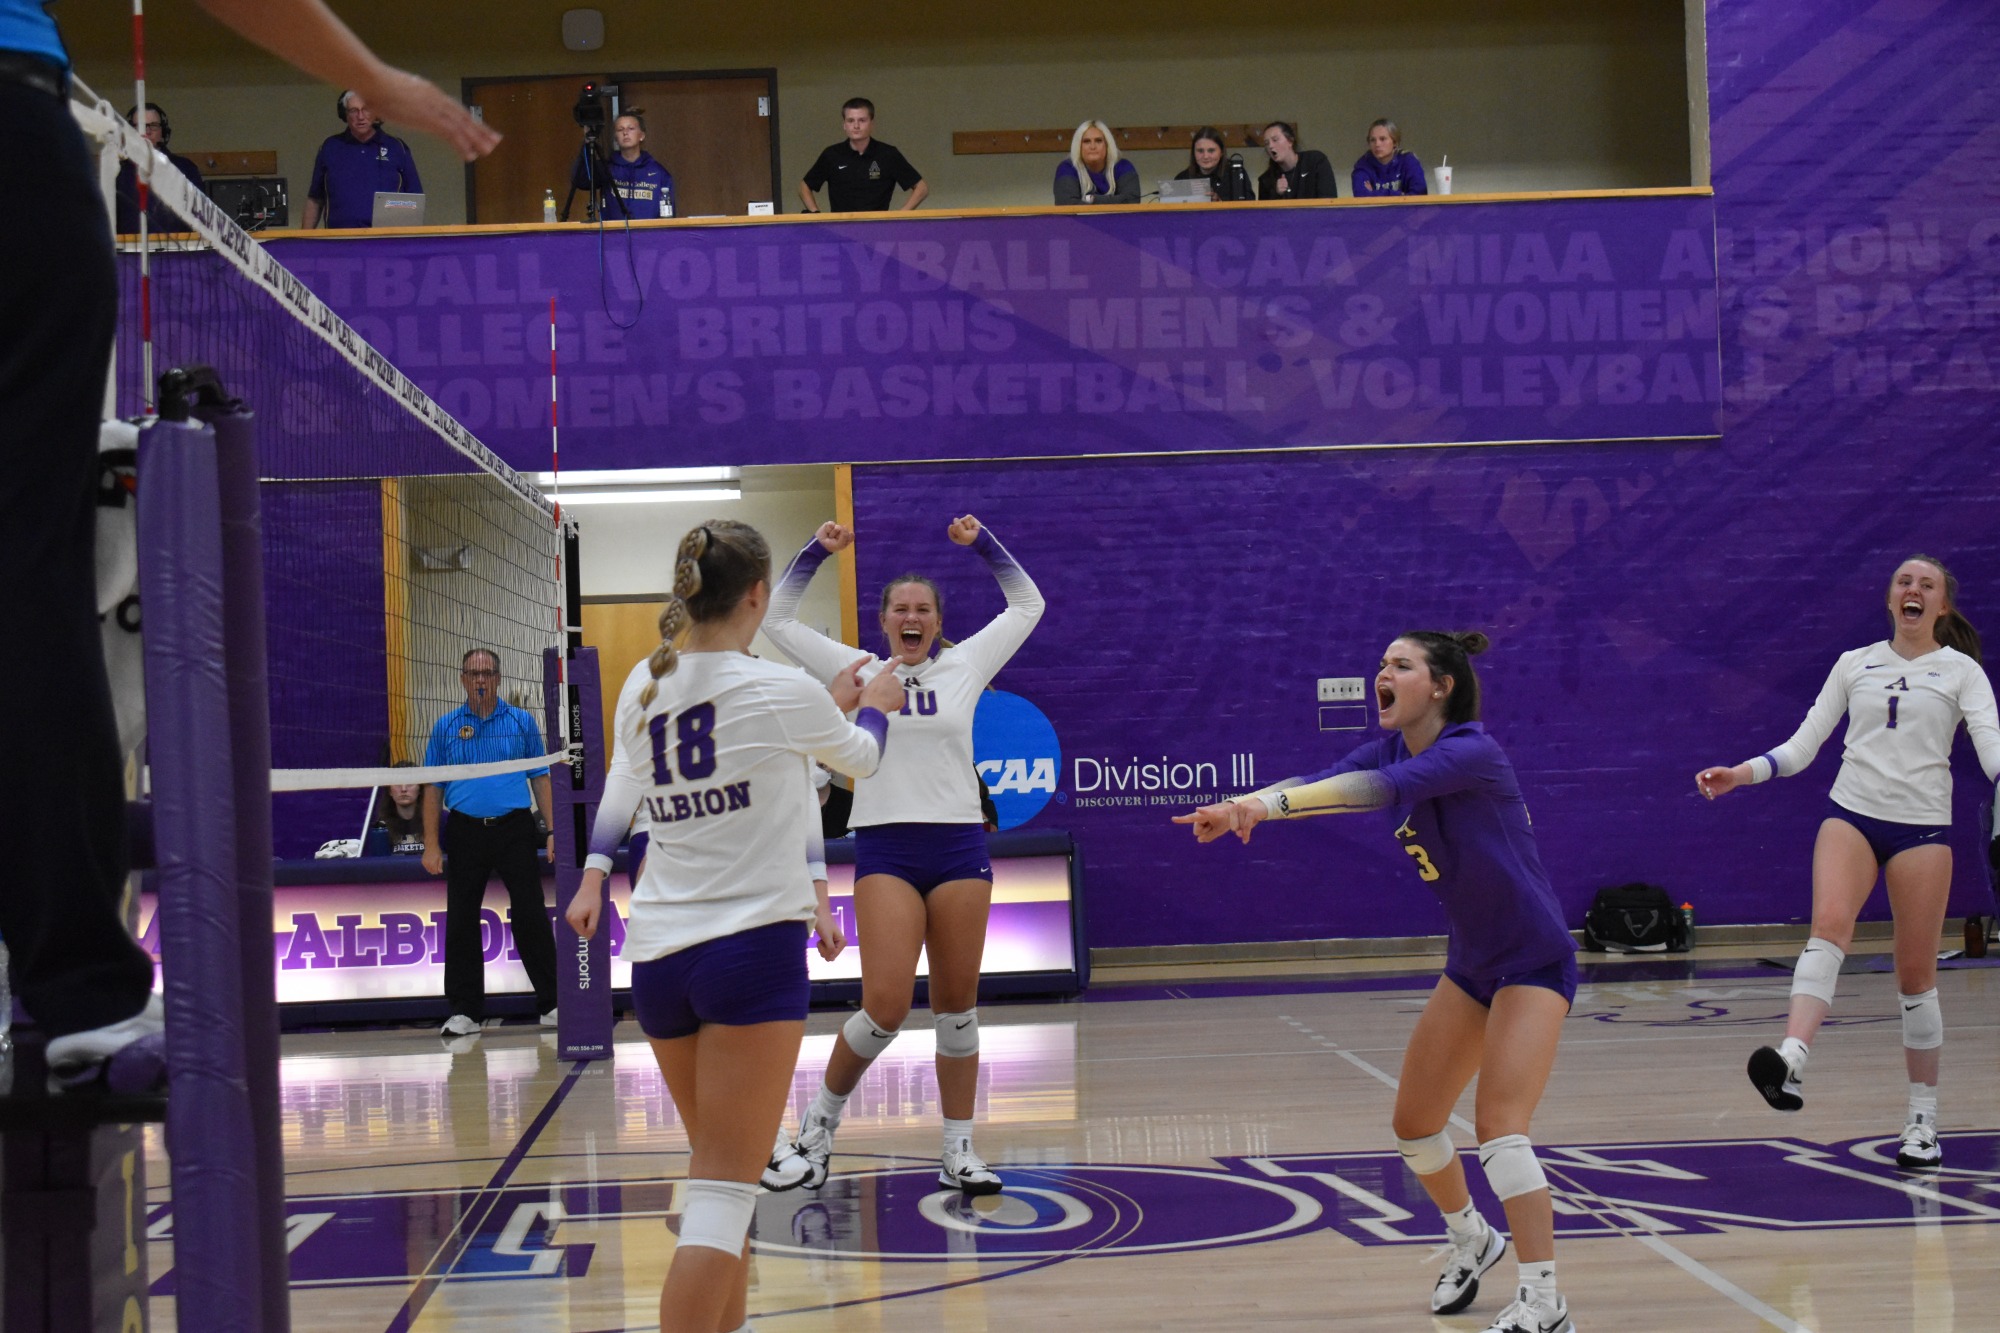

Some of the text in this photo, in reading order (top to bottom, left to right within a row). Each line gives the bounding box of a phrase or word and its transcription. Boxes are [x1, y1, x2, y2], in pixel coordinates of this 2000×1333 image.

[602, 238, 1089, 300] VOLLEYBALL
[1138, 235, 1357, 289] NCAA
[1407, 230, 1614, 285] MIAA
[679, 299, 1017, 360] BRITONS
[1068, 295, 1313, 350] MEN'S
[1339, 294, 1401, 347] &
[773, 360, 1266, 420] BASKETBALL
[1884, 676, 1909, 691] A
[1887, 696, 1899, 728] 1
[649, 700, 717, 786] 18
[974, 757, 1057, 795] CAA
[1074, 753, 1255, 792] Division III
[1075, 795, 1143, 808] DISCOVER
[1150, 793, 1213, 806] DEVELOP
[1405, 844, 1440, 882] 3
